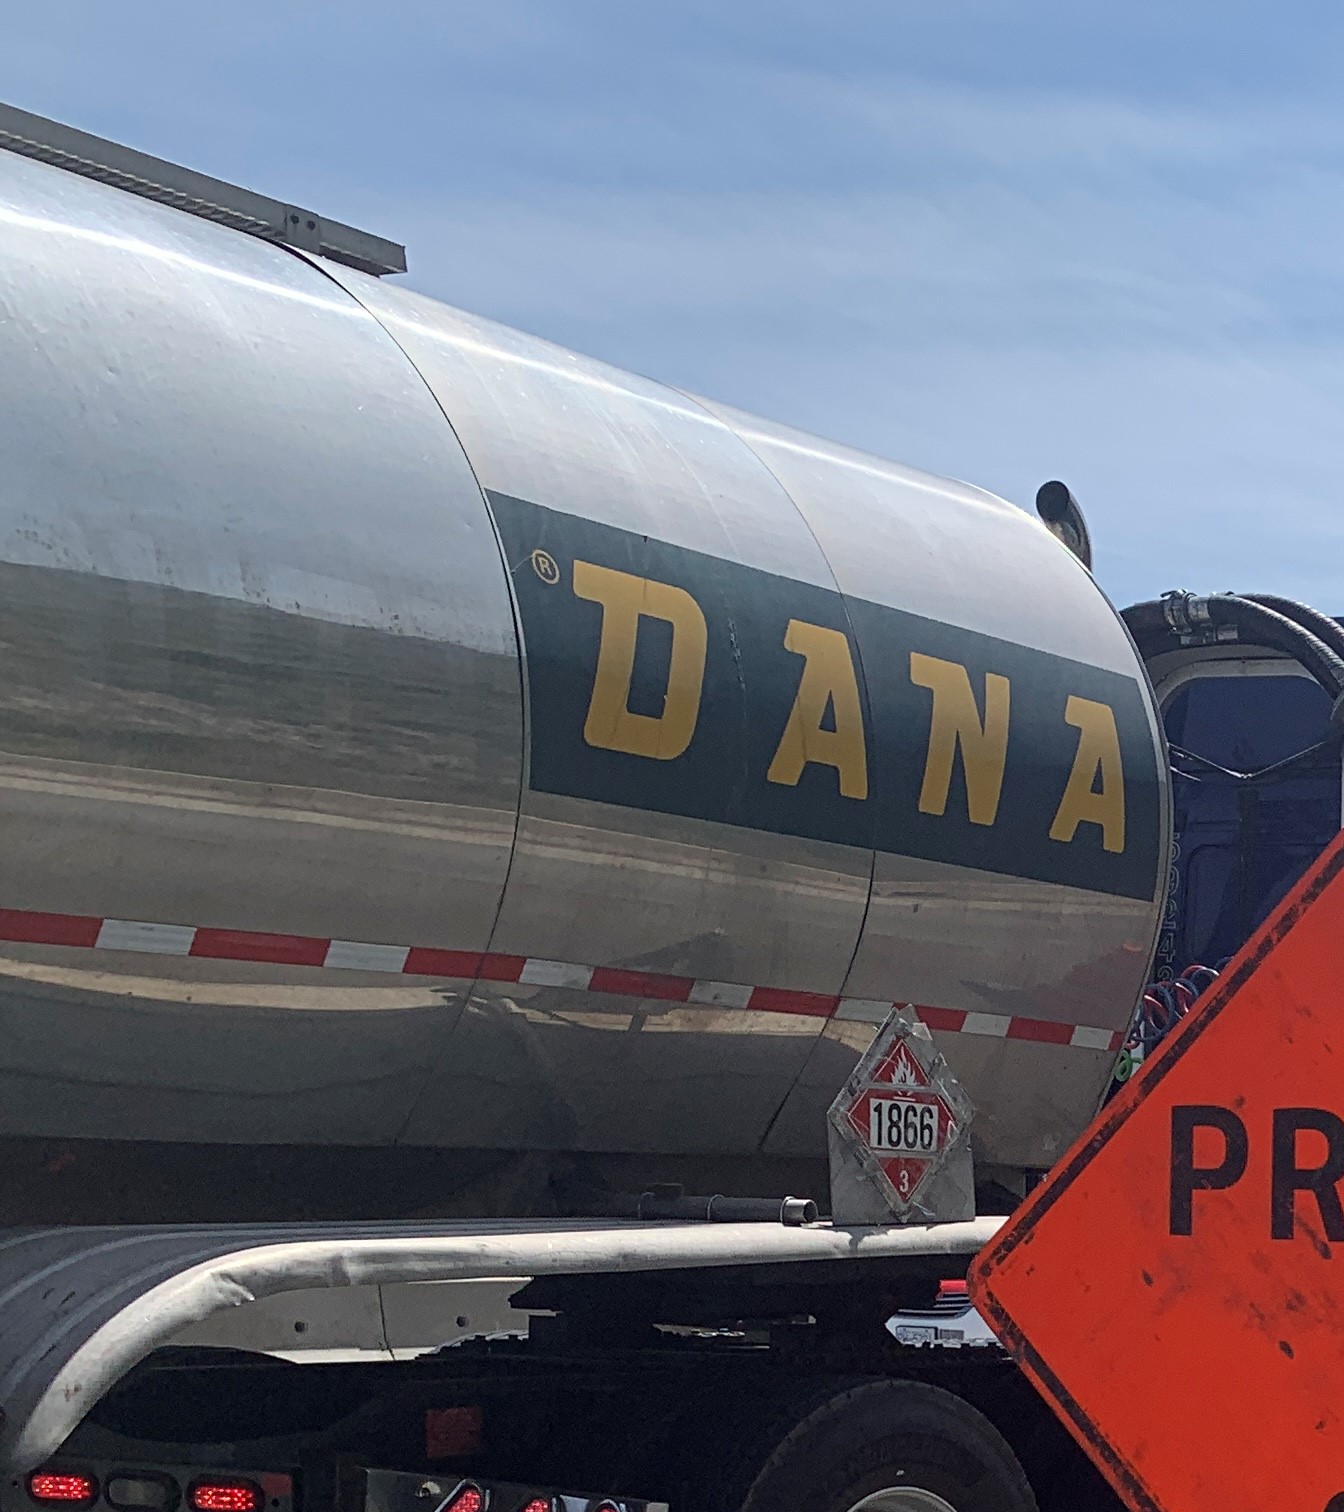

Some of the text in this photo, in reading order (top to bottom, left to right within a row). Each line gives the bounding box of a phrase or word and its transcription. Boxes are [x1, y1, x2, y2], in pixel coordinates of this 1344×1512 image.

[572, 559, 1126, 854] DANA
[873, 1102, 934, 1150] 1866
[899, 1170, 909, 1192] 3
